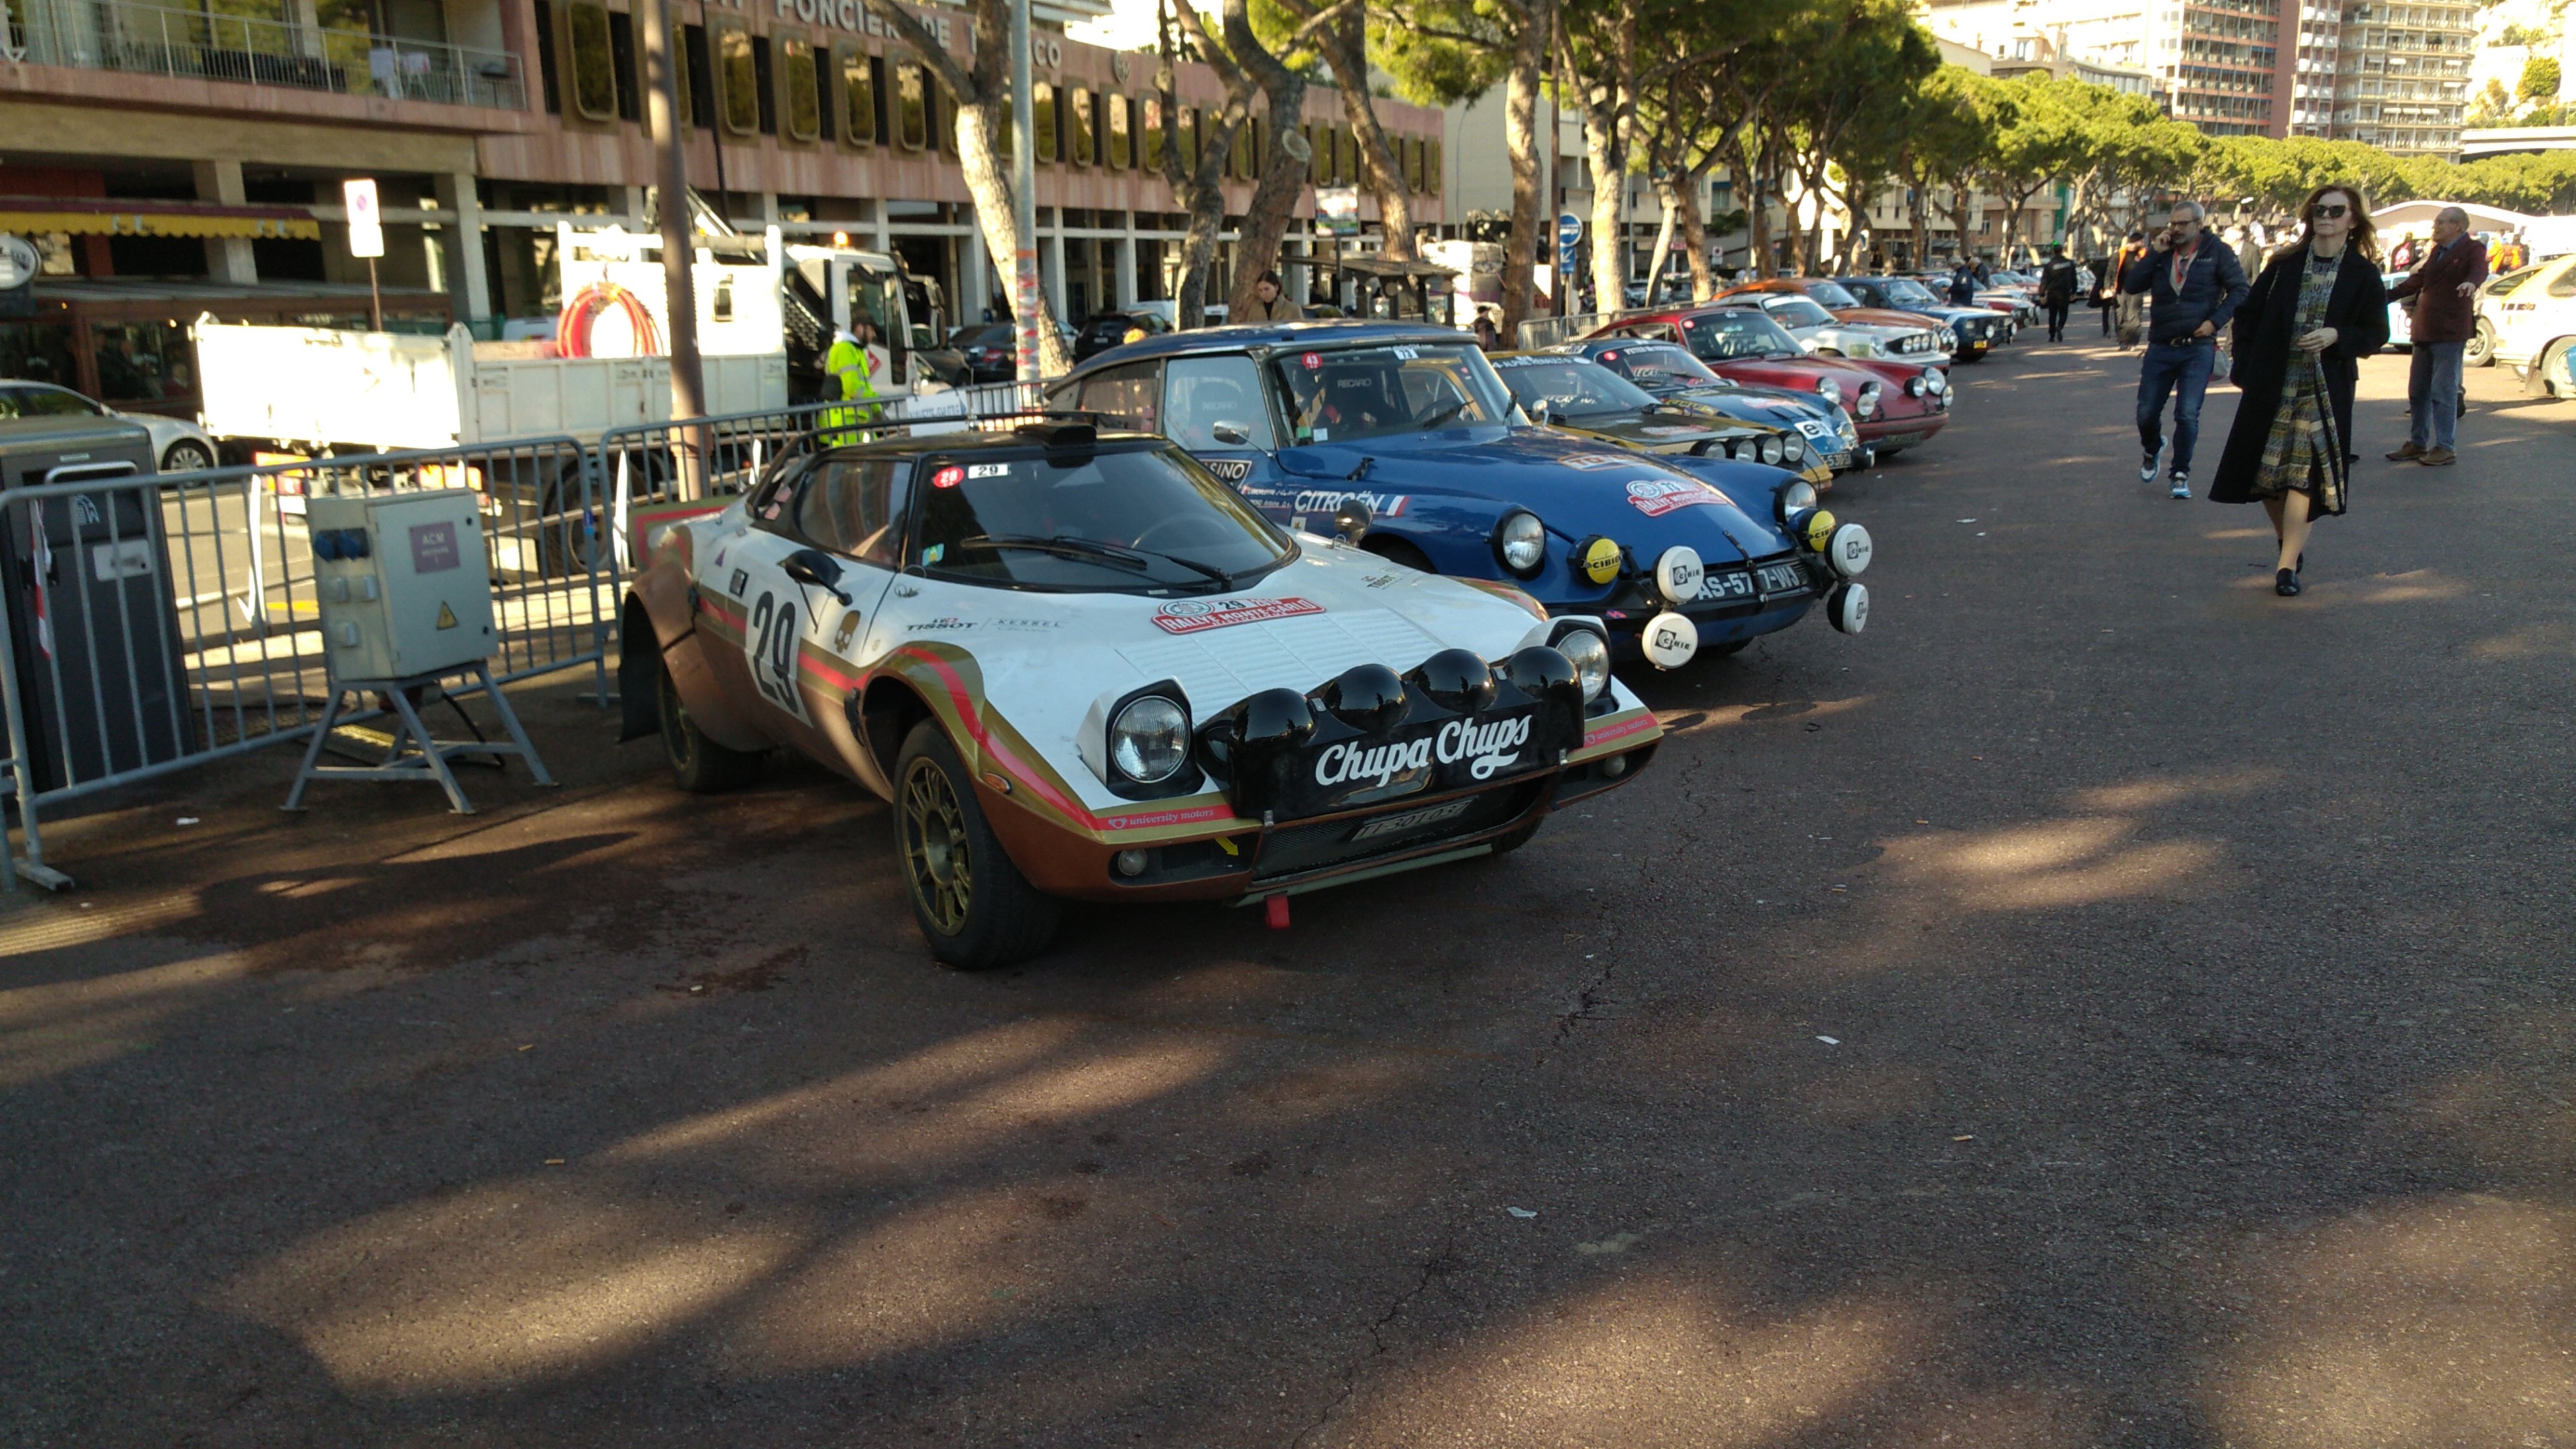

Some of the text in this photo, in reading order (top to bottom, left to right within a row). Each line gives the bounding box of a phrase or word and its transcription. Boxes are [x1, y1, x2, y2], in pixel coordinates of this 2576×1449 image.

[920, 15, 952, 50] DE
[1306, 354, 1319, 365] 43
[1337, 378, 1372, 388] RECARO
[978, 466, 999, 476] 29
[1219, 600, 1246, 610] 29
[907, 619, 1065, 631] TISSOT KESSEL
[1161, 615, 1218, 630] RALLYE
[753, 591, 798, 714] 29
[1597, 725, 1626, 740] university
[1316, 714, 1533, 788] Chupa Chups
[1130, 809, 1214, 825] university motors
